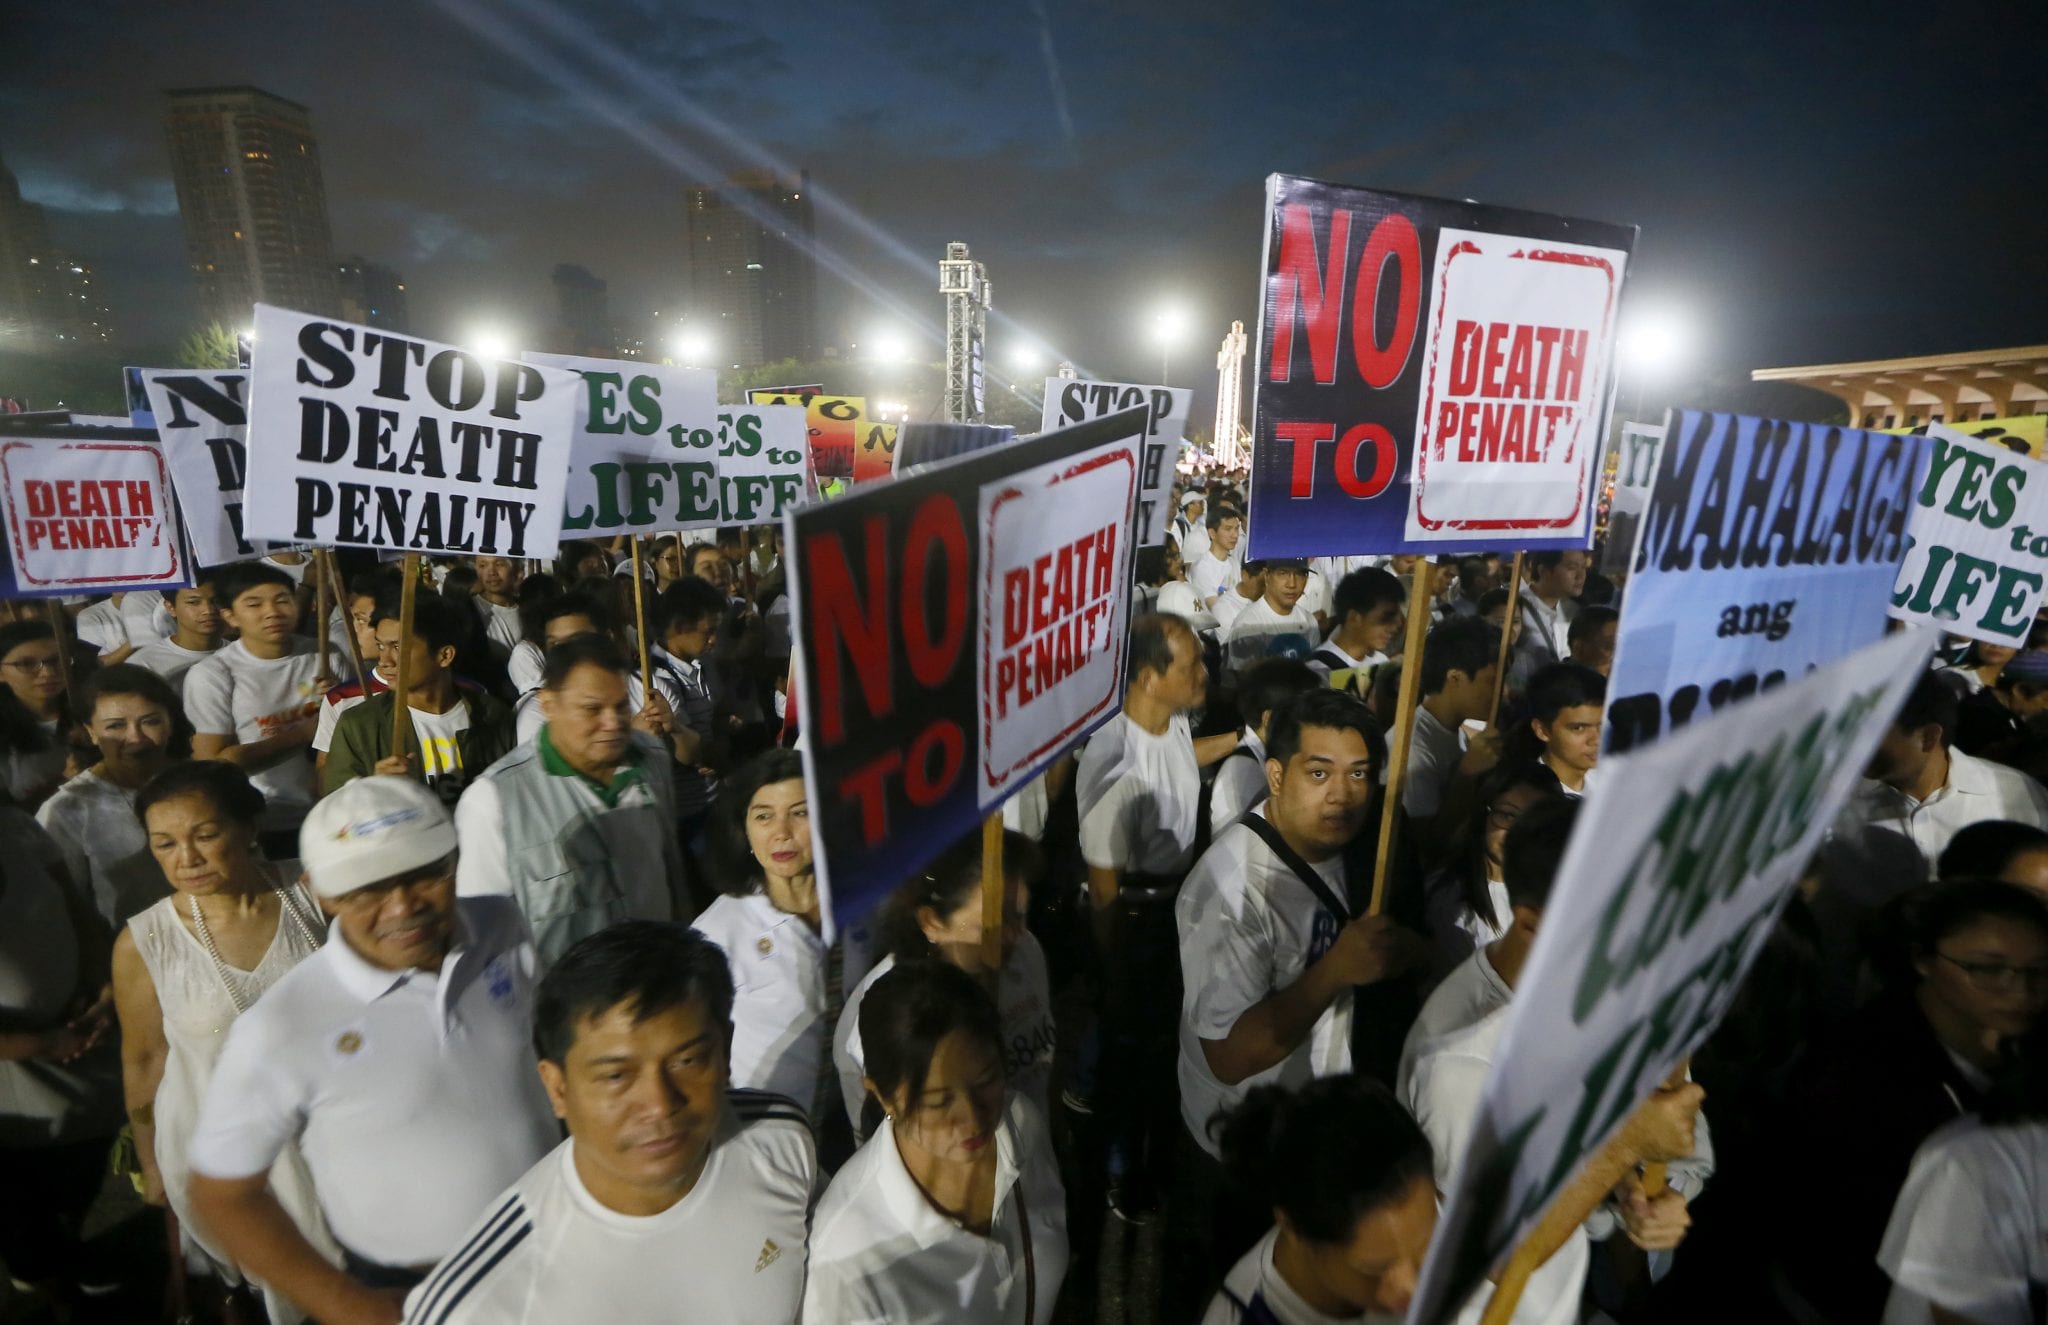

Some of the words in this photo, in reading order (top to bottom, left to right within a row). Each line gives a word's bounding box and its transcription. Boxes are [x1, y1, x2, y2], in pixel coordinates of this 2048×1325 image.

[1271, 202, 1423, 389] NO
[297, 321, 546, 421] STOP
[1448, 320, 1589, 401] DEATH
[297, 397, 543, 491] DEATH
[566, 369, 663, 436] ES
[667, 424, 714, 448] to
[718, 413, 762, 457] ES
[765, 447, 802, 465] to
[24, 479, 154, 518] DEATH
[1276, 422, 1398, 500] TO
[1634, 409, 1920, 573] MAHALAGA
[1918, 437, 2027, 530] YES
[2010, 526, 2048, 558] to
[294, 476, 535, 556] PENALTY
[807, 492, 968, 746] NO
[1003, 522, 1116, 651] DEATH
[1717, 599, 1797, 642] ang
[838, 720, 965, 847] TO
